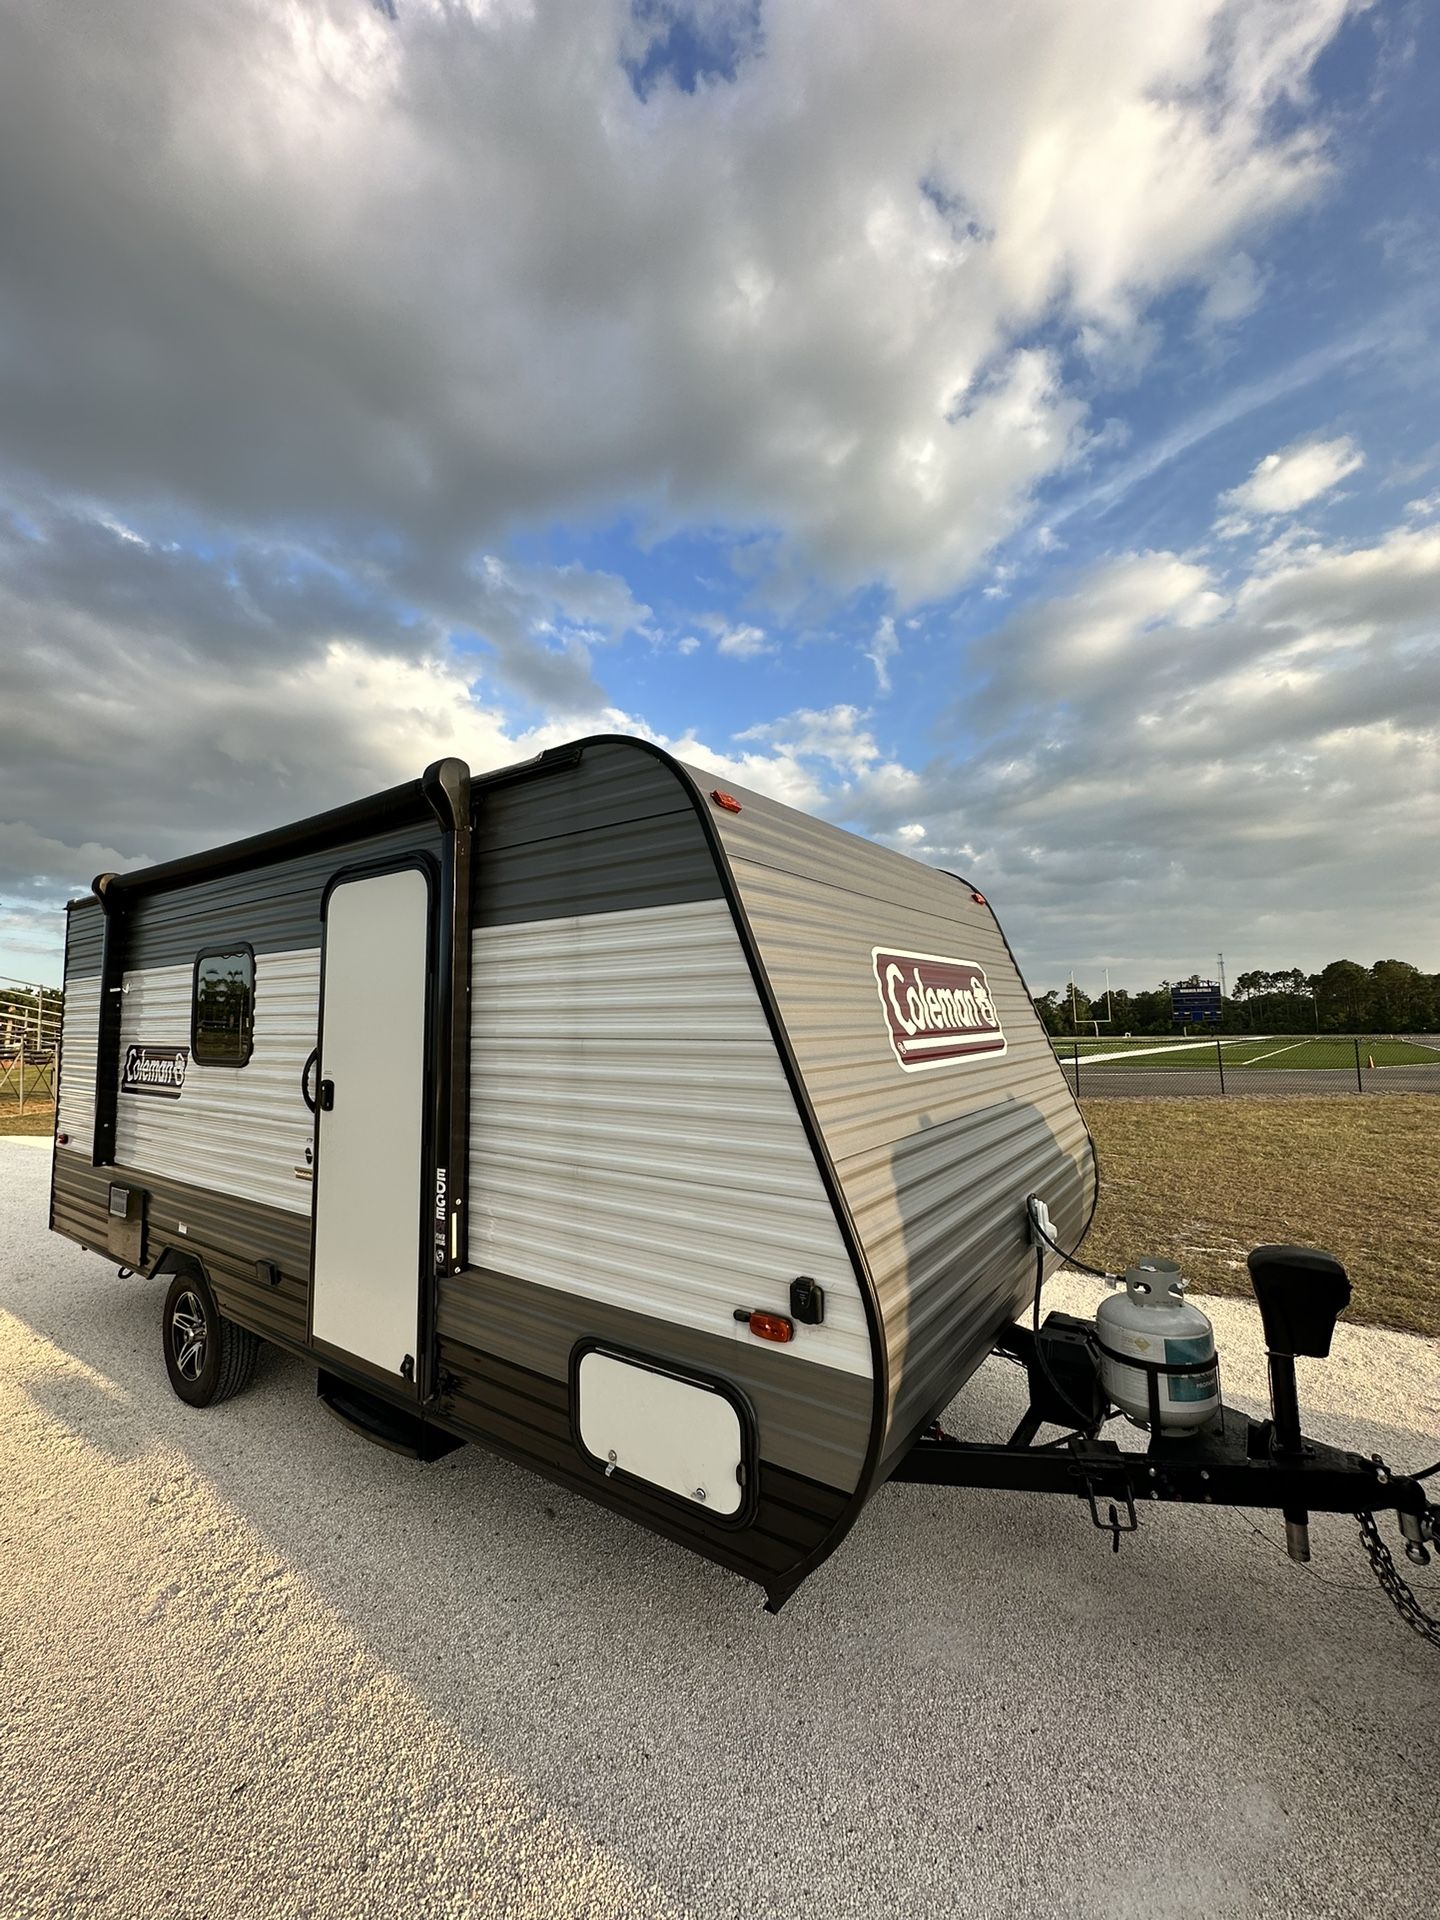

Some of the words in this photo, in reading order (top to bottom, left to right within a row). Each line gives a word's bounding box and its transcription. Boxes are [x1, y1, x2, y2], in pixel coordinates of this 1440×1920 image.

[886, 963, 982, 1036] Coleman
[126, 1048, 174, 1083] Coleman
[435, 1167, 446, 1220] EDGE
